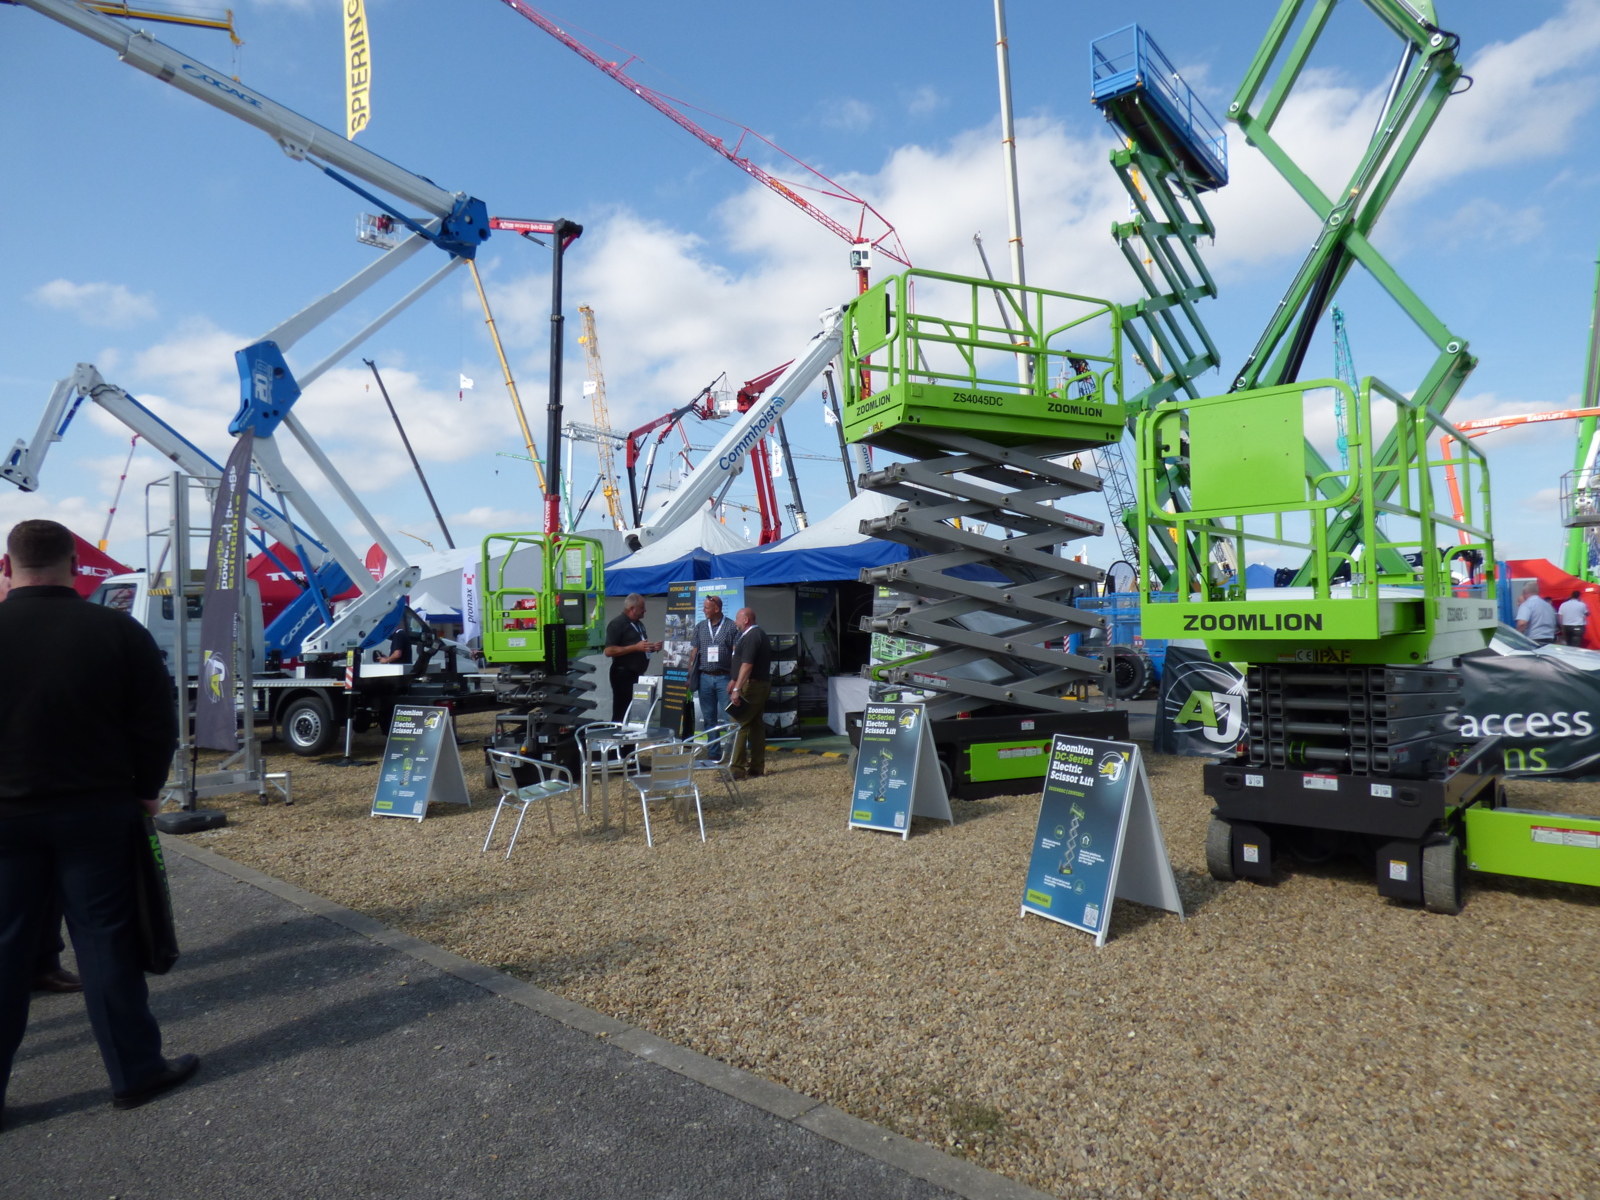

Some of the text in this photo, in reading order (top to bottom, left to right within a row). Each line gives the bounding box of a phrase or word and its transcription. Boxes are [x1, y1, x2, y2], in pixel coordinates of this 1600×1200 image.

[856, 393, 891, 416] ZOOMLION
[953, 392, 1004, 407] ZS4045DC
[1047, 402, 1103, 418] ZOOMLION
[719, 404, 779, 470] Commhoist
[466, 588, 476, 624] promax
[1183, 613, 1322, 631] ZOOMLION
[1314, 646, 1351, 663] IPAF
[396, 709, 424, 717] Zoomlion
[866, 713, 896, 721] DC-Series
[1173, 690, 1242, 744] AJ
[864, 727, 886, 735] Scissor
[865, 720, 888, 728] Electric
[1460, 711, 1593, 737] access
[1056, 741, 1094, 756] Zoomlion
[1054, 751, 1094, 766] DC-Series
[1052, 761, 1083, 774] Electric
[1101, 761, 1122, 781] AJ
[1050, 770, 1094, 787] Scissor Lift
